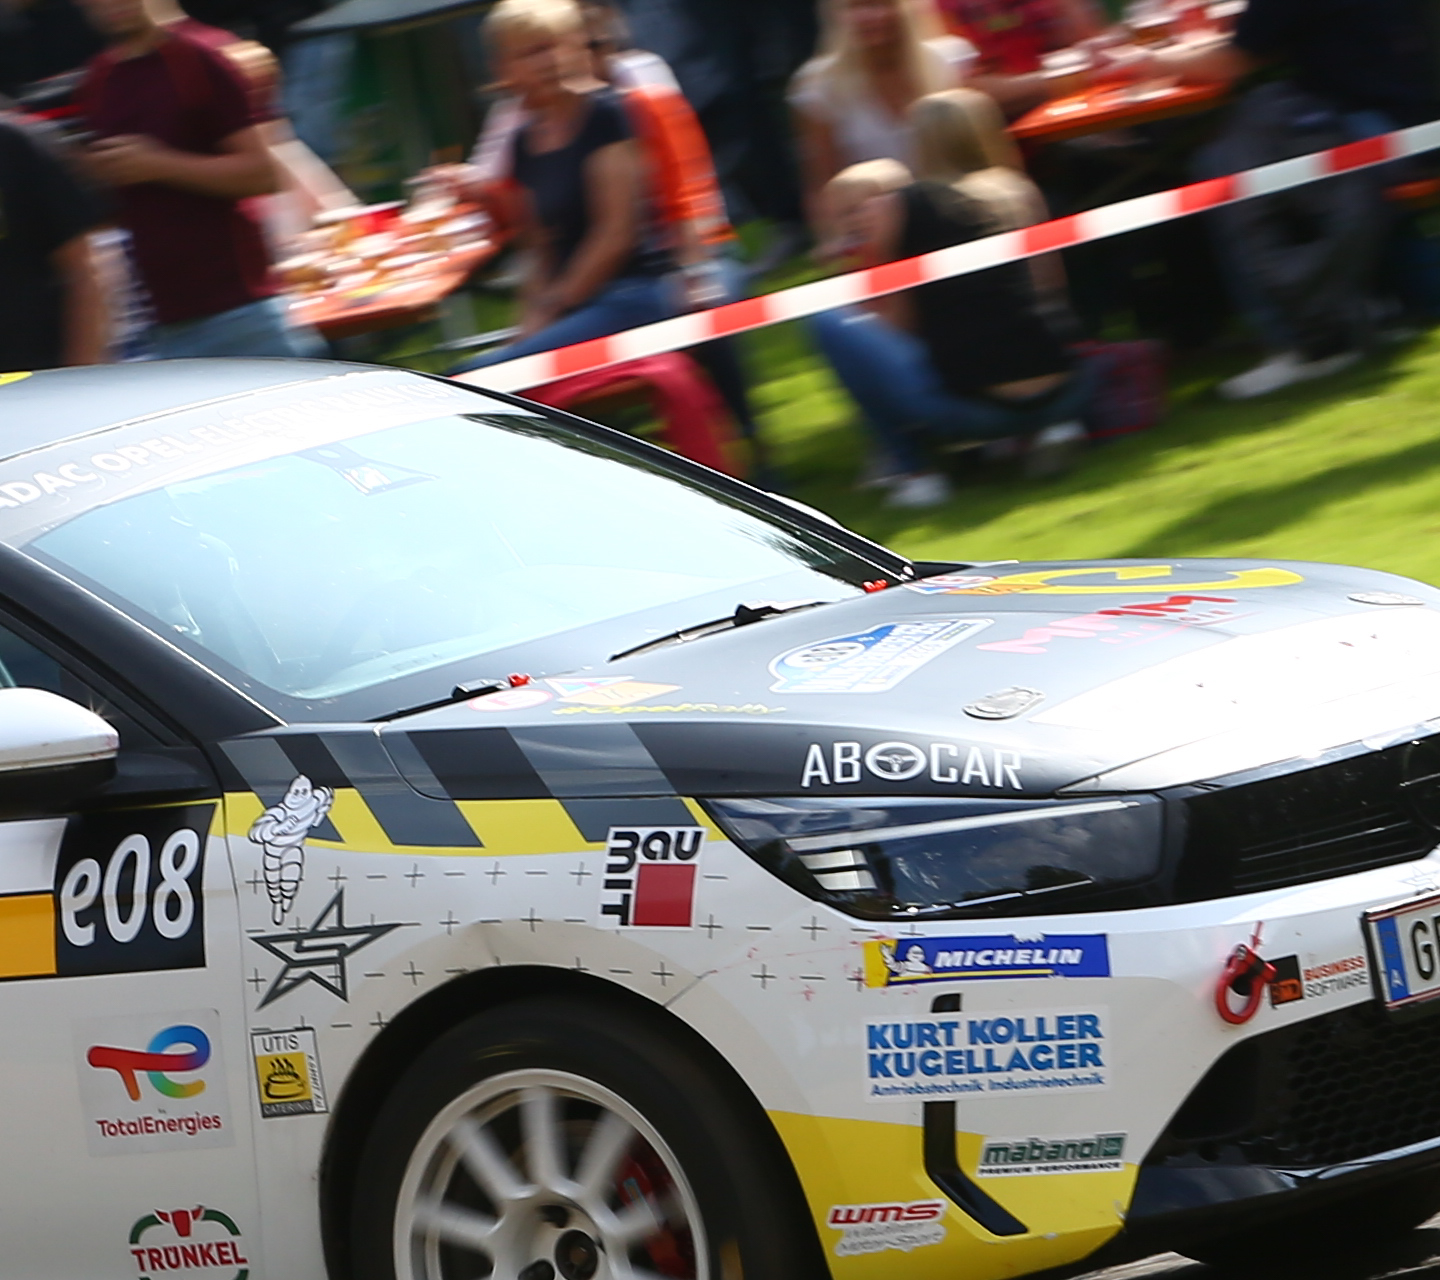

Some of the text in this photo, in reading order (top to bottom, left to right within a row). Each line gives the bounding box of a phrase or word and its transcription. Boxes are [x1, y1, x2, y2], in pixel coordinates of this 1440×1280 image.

[91, 431, 191, 475] OPEL
[59, 828, 200, 947] e08
[934, 948, 1083, 968] MICHELIN
[1303, 954, 1366, 982] BUSINESS
[1304, 969, 1369, 999] SOFTWARE
[261, 1033, 301, 1053] UTIS
[867, 1013, 1105, 1050] KURT KOLLER
[867, 1042, 1106, 1079] KUGELLAGER
[871, 1072, 1105, 1097] Antriebstechnik Industrietechnik
[96, 1111, 223, 1137] TotalEnergies
[984, 1134, 1104, 1165] mabanol
[979, 1161, 1120, 1175] PREMIUM PERFORMANCE
[130, 1240, 248, 1272] TRÜNKEL
